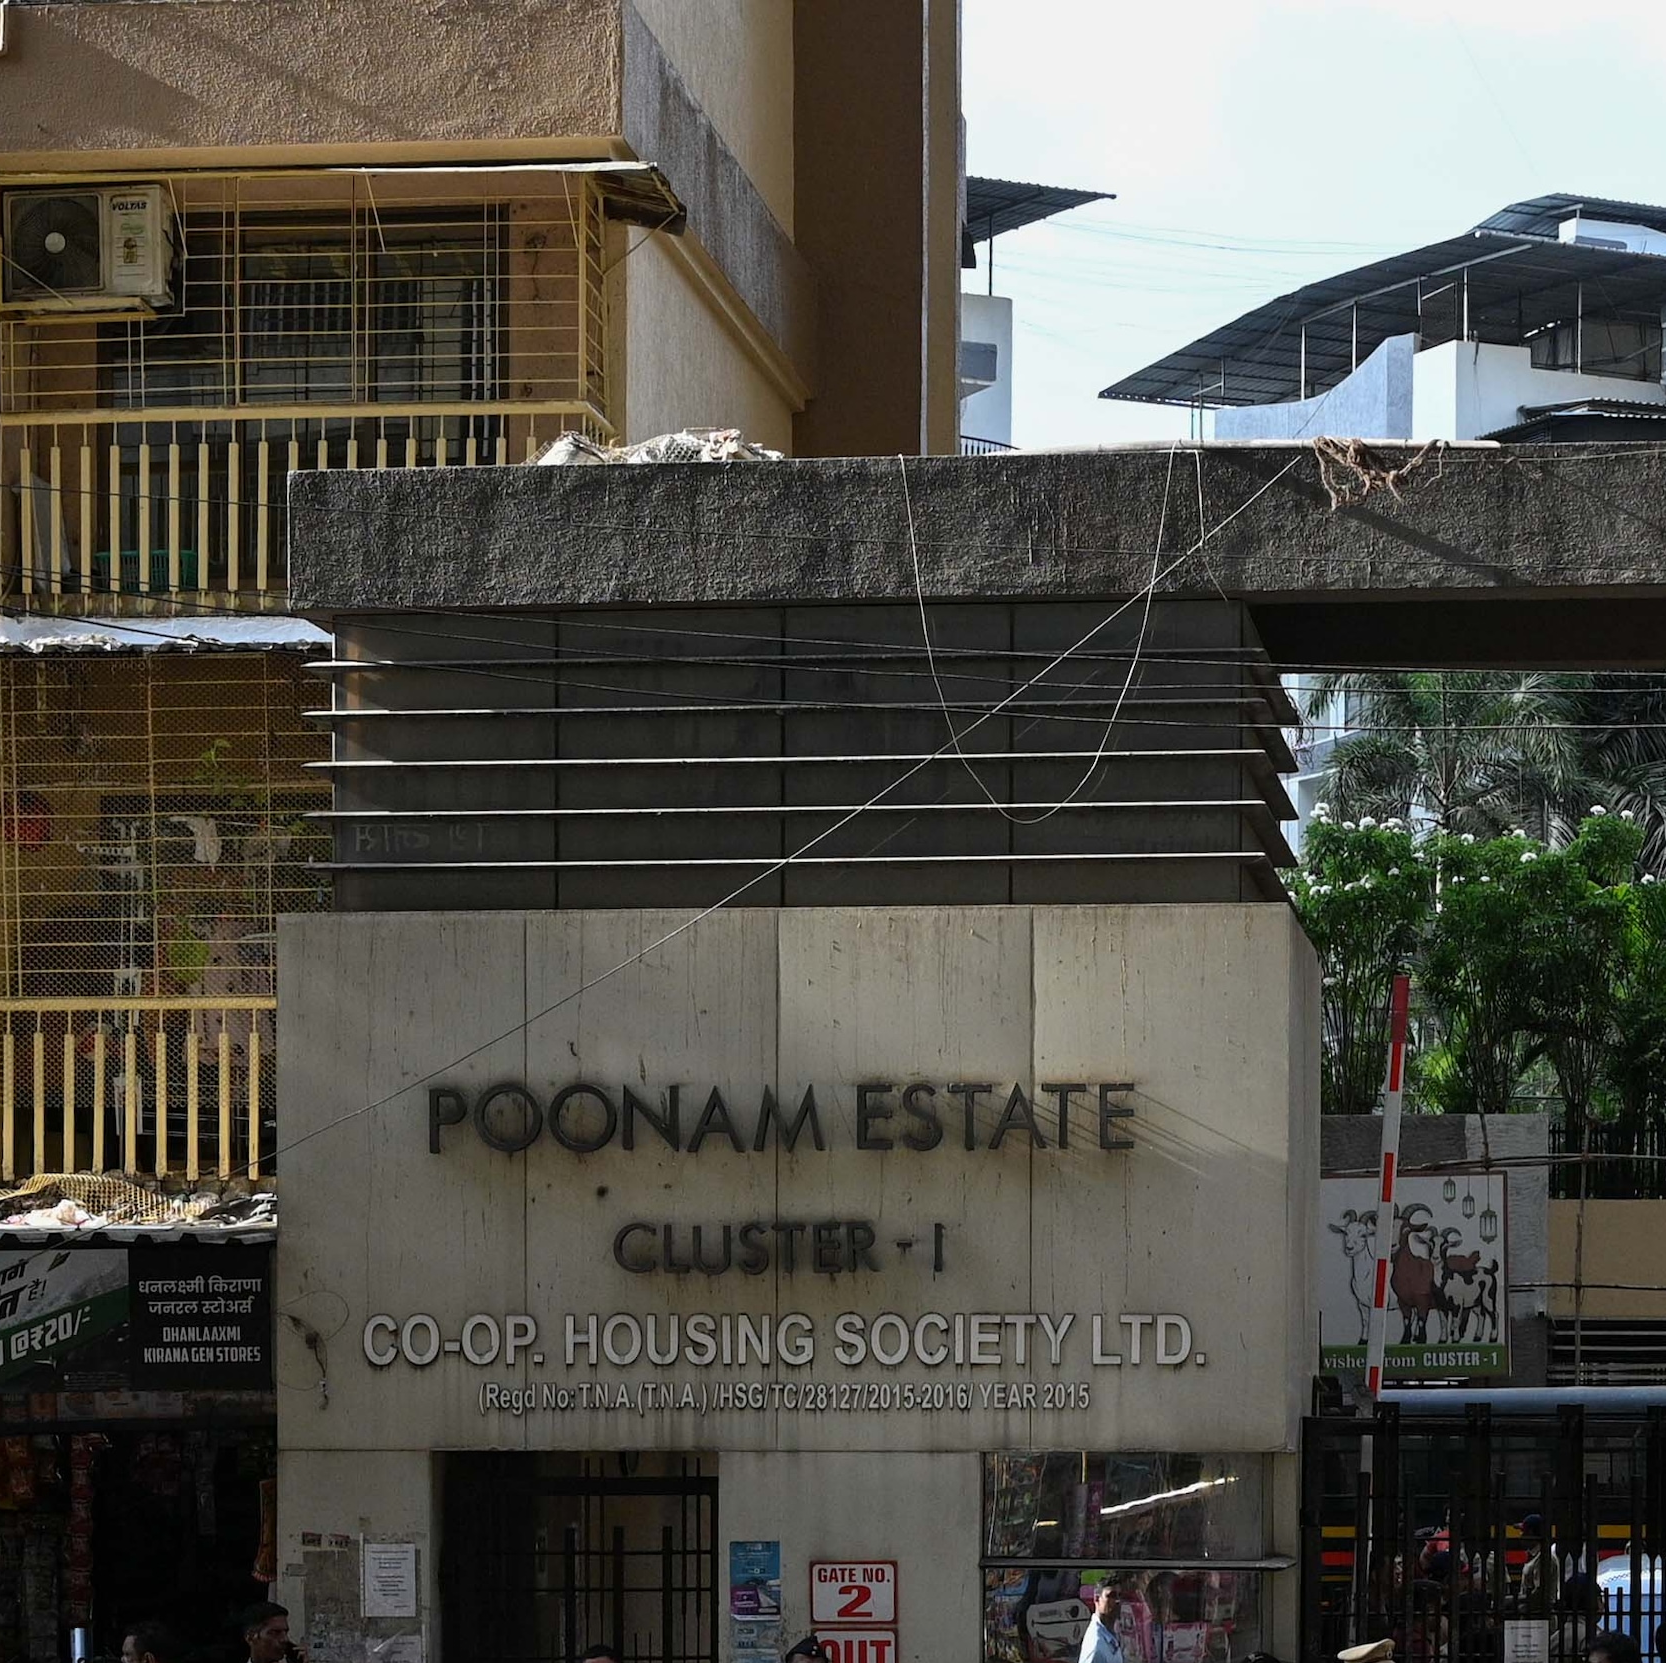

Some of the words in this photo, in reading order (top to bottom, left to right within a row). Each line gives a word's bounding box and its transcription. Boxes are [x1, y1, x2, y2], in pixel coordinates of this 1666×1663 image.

[112, 201, 148, 211] VOLTAS
[428, 1082, 827, 1154] POONAM
[856, 1082, 1136, 1152] ESTATE
[613, 1222, 879, 1275] CLUSTER
[147, 1300, 199, 1316] जनरल
[162, 1325, 242, 1343] DHANLAAXMI
[362, 1313, 545, 1370] CO-OP.
[564, 1313, 816, 1368] HOUSING
[832, 1313, 1078, 1368] SOCIETY
[1092, 1313, 1208, 1367] LTD.
[143, 1346, 189, 1364] KIRANA
[191, 1346, 215, 1363] GEN
[216, 1345, 262, 1363] STORES
[1384, 1355, 1416, 1368] rom
[1423, 1351, 1481, 1367] CLUSTER
[979, 1382, 1036, 1410] YEAR
[1042, 1382, 1090, 1410] 2015
[817, 1567, 857, 1584] GATE
[862, 1567, 891, 1584] NO.
[837, 1585, 873, 1618] 2
